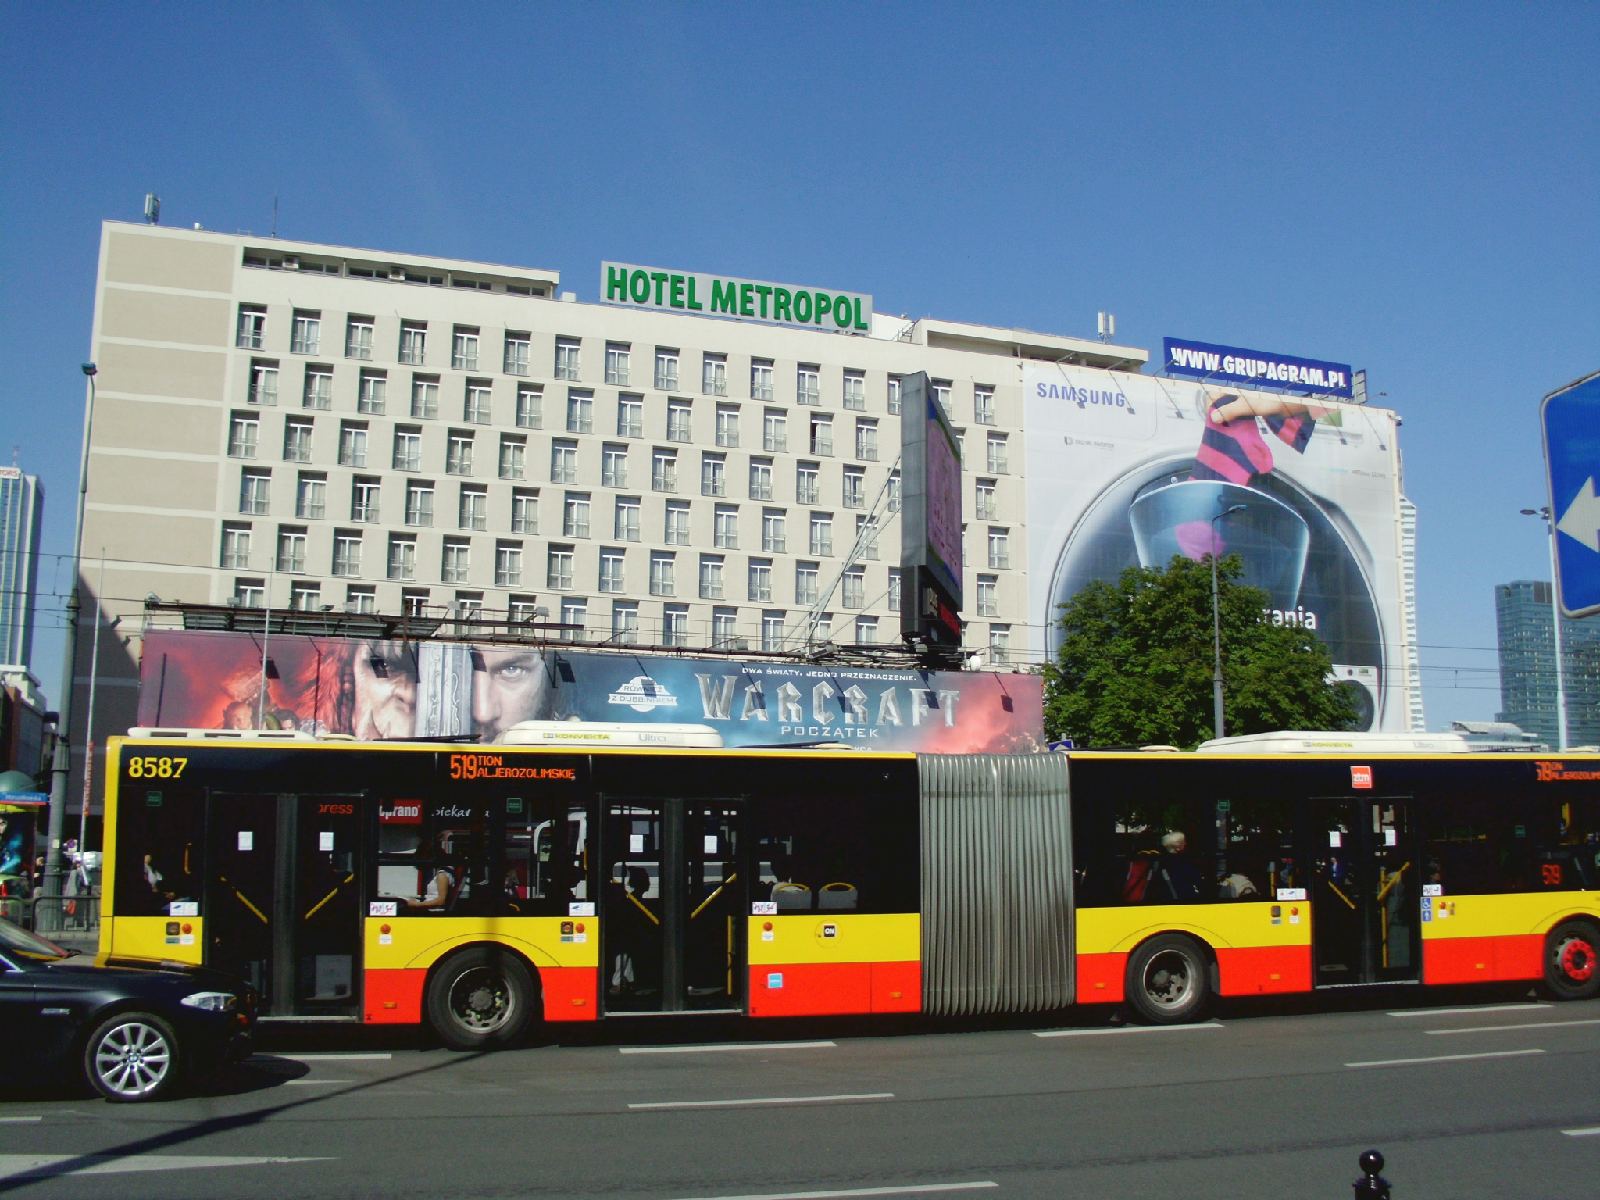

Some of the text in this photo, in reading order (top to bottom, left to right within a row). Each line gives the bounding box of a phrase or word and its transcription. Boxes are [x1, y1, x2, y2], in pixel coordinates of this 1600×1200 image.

[607, 266, 868, 331] HOTEL METROPOL
[1170, 347, 1347, 388] WWW.GRUPAGRAM.PL
[1036, 382, 1125, 408] SAMSUNG
[741, 666, 763, 674] DWA
[695, 673, 960, 728] WARCRAFT
[780, 725, 879, 739] POCZĄTEK
[128, 756, 188, 778] 8587
[450, 754, 477, 779] 519
